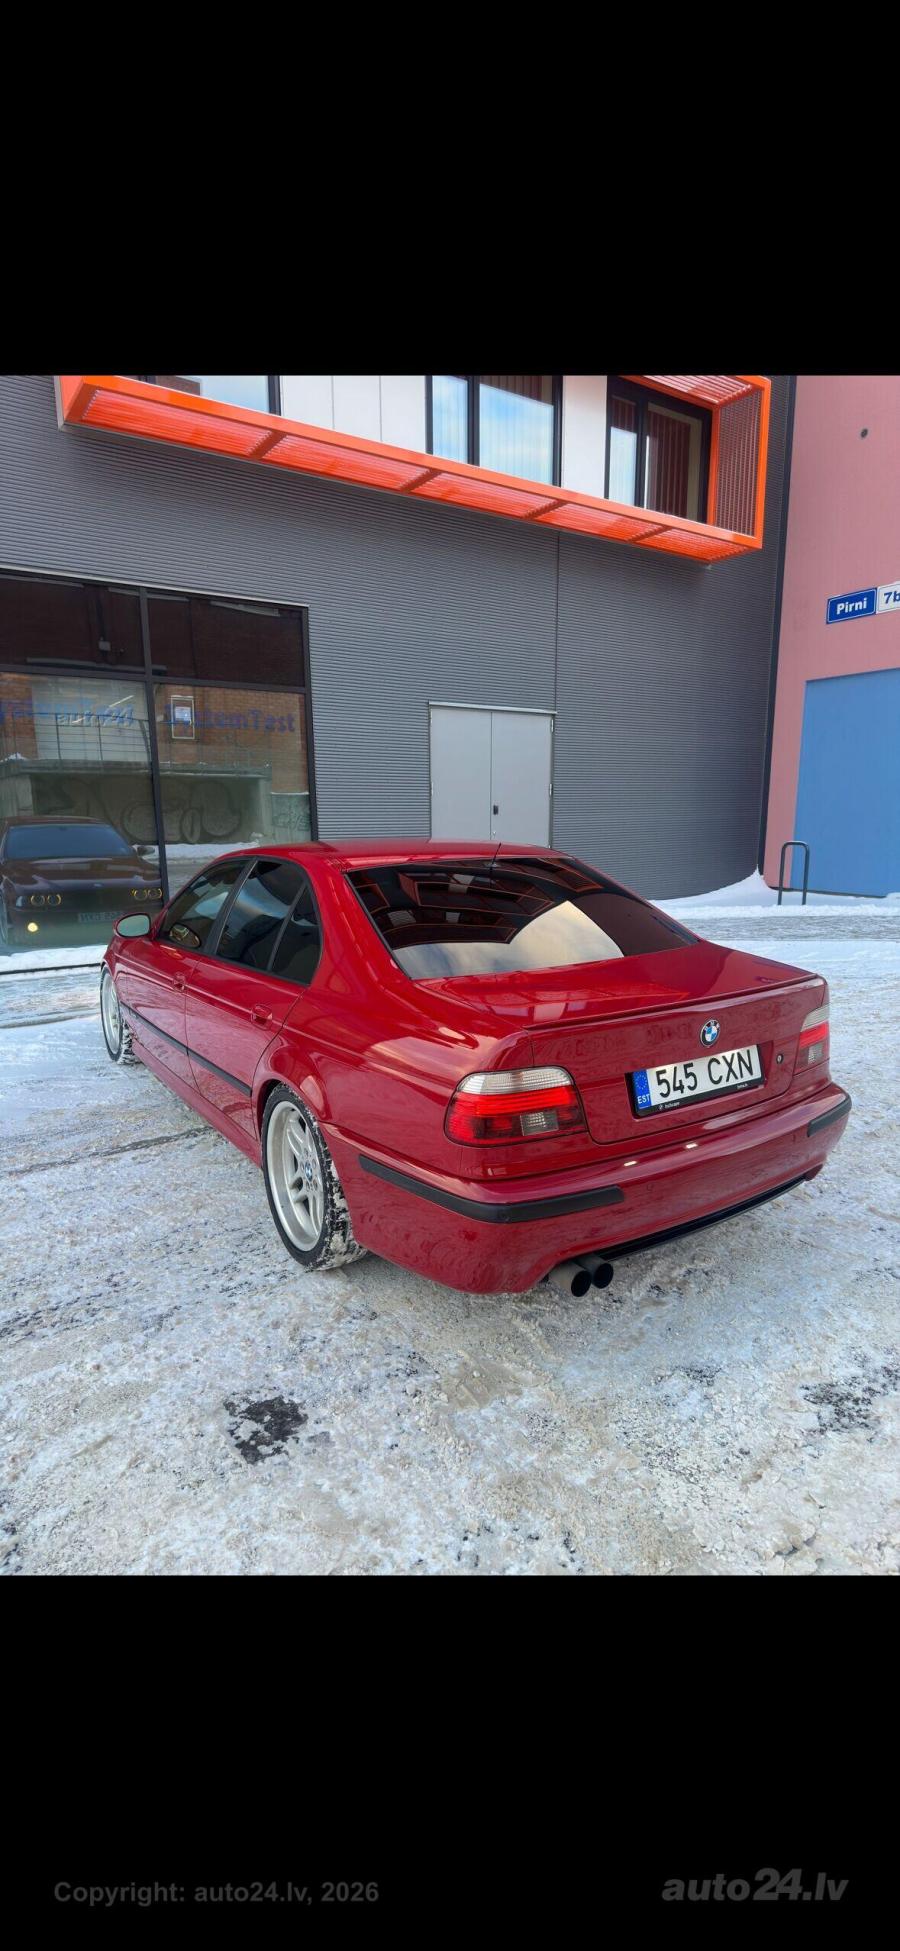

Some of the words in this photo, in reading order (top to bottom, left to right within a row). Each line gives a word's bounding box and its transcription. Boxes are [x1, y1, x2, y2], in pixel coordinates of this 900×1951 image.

[836, 597, 868, 615] Pirni
[656, 1062, 698, 1099] 545
[707, 1049, 754, 1085] CXN
[637, 1093, 651, 1105] EST
